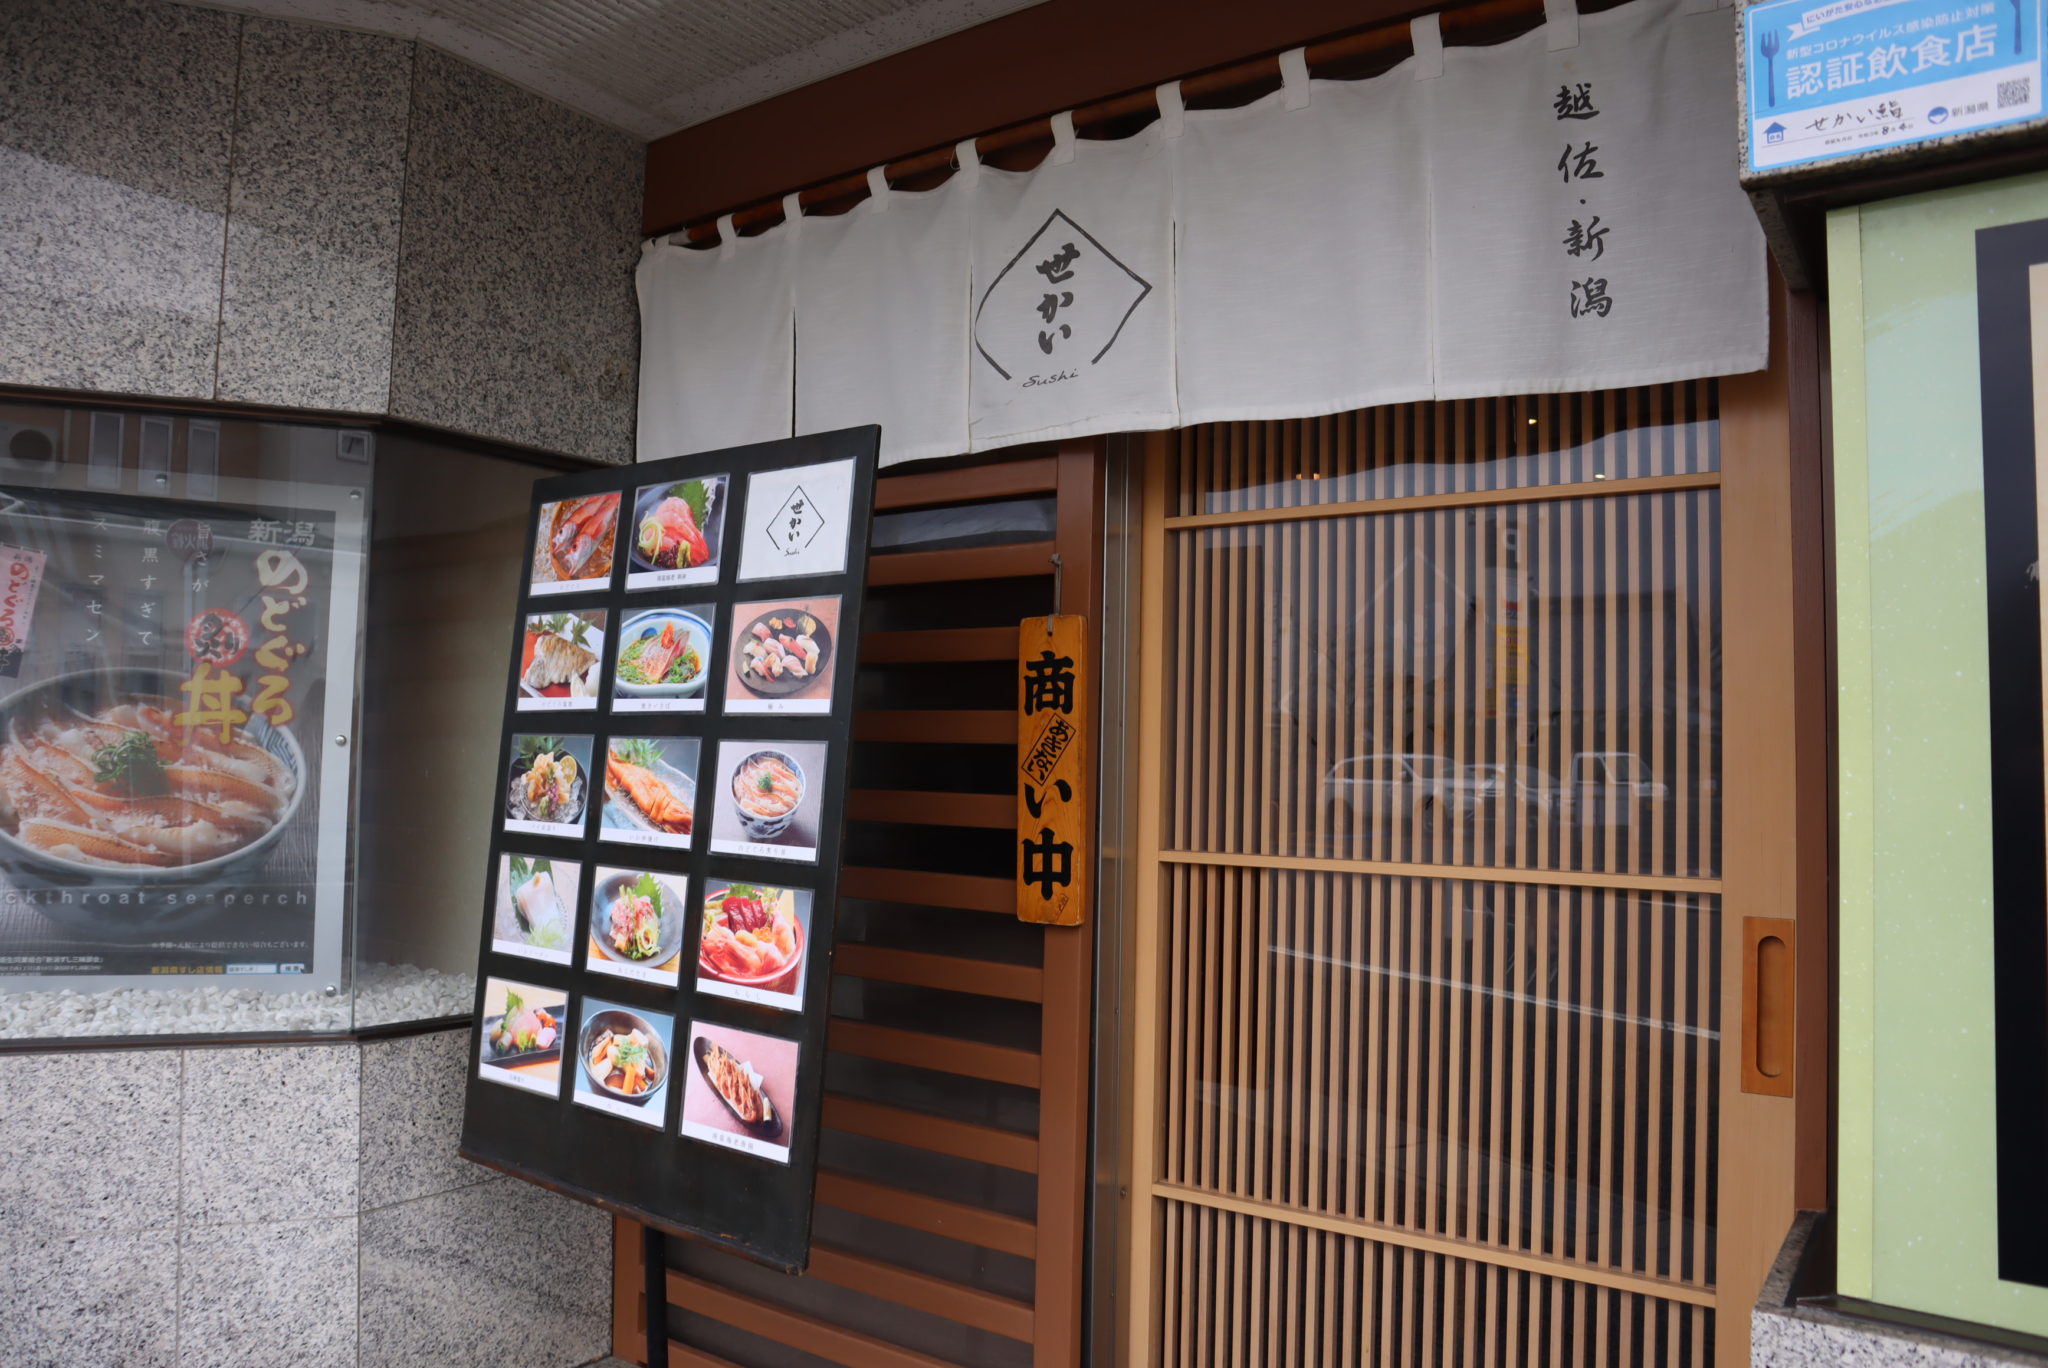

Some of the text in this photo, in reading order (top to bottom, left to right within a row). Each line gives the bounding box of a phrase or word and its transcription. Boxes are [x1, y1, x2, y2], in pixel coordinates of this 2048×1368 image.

[1786, 23, 1998, 100] 認証飲食店
[1035, 242, 1081, 356] 世かい
[1022, 367, 1080, 389] Sushi
[86, 517, 107, 642] スミマセン
[137, 519, 162, 646] 腹黒すぎて
[249, 518, 316, 546] 新潟
[252, 549, 309, 727] のどぐろ
[1021, 650, 1076, 901] 商い中
[167, 890, 308, 908] seaperch
